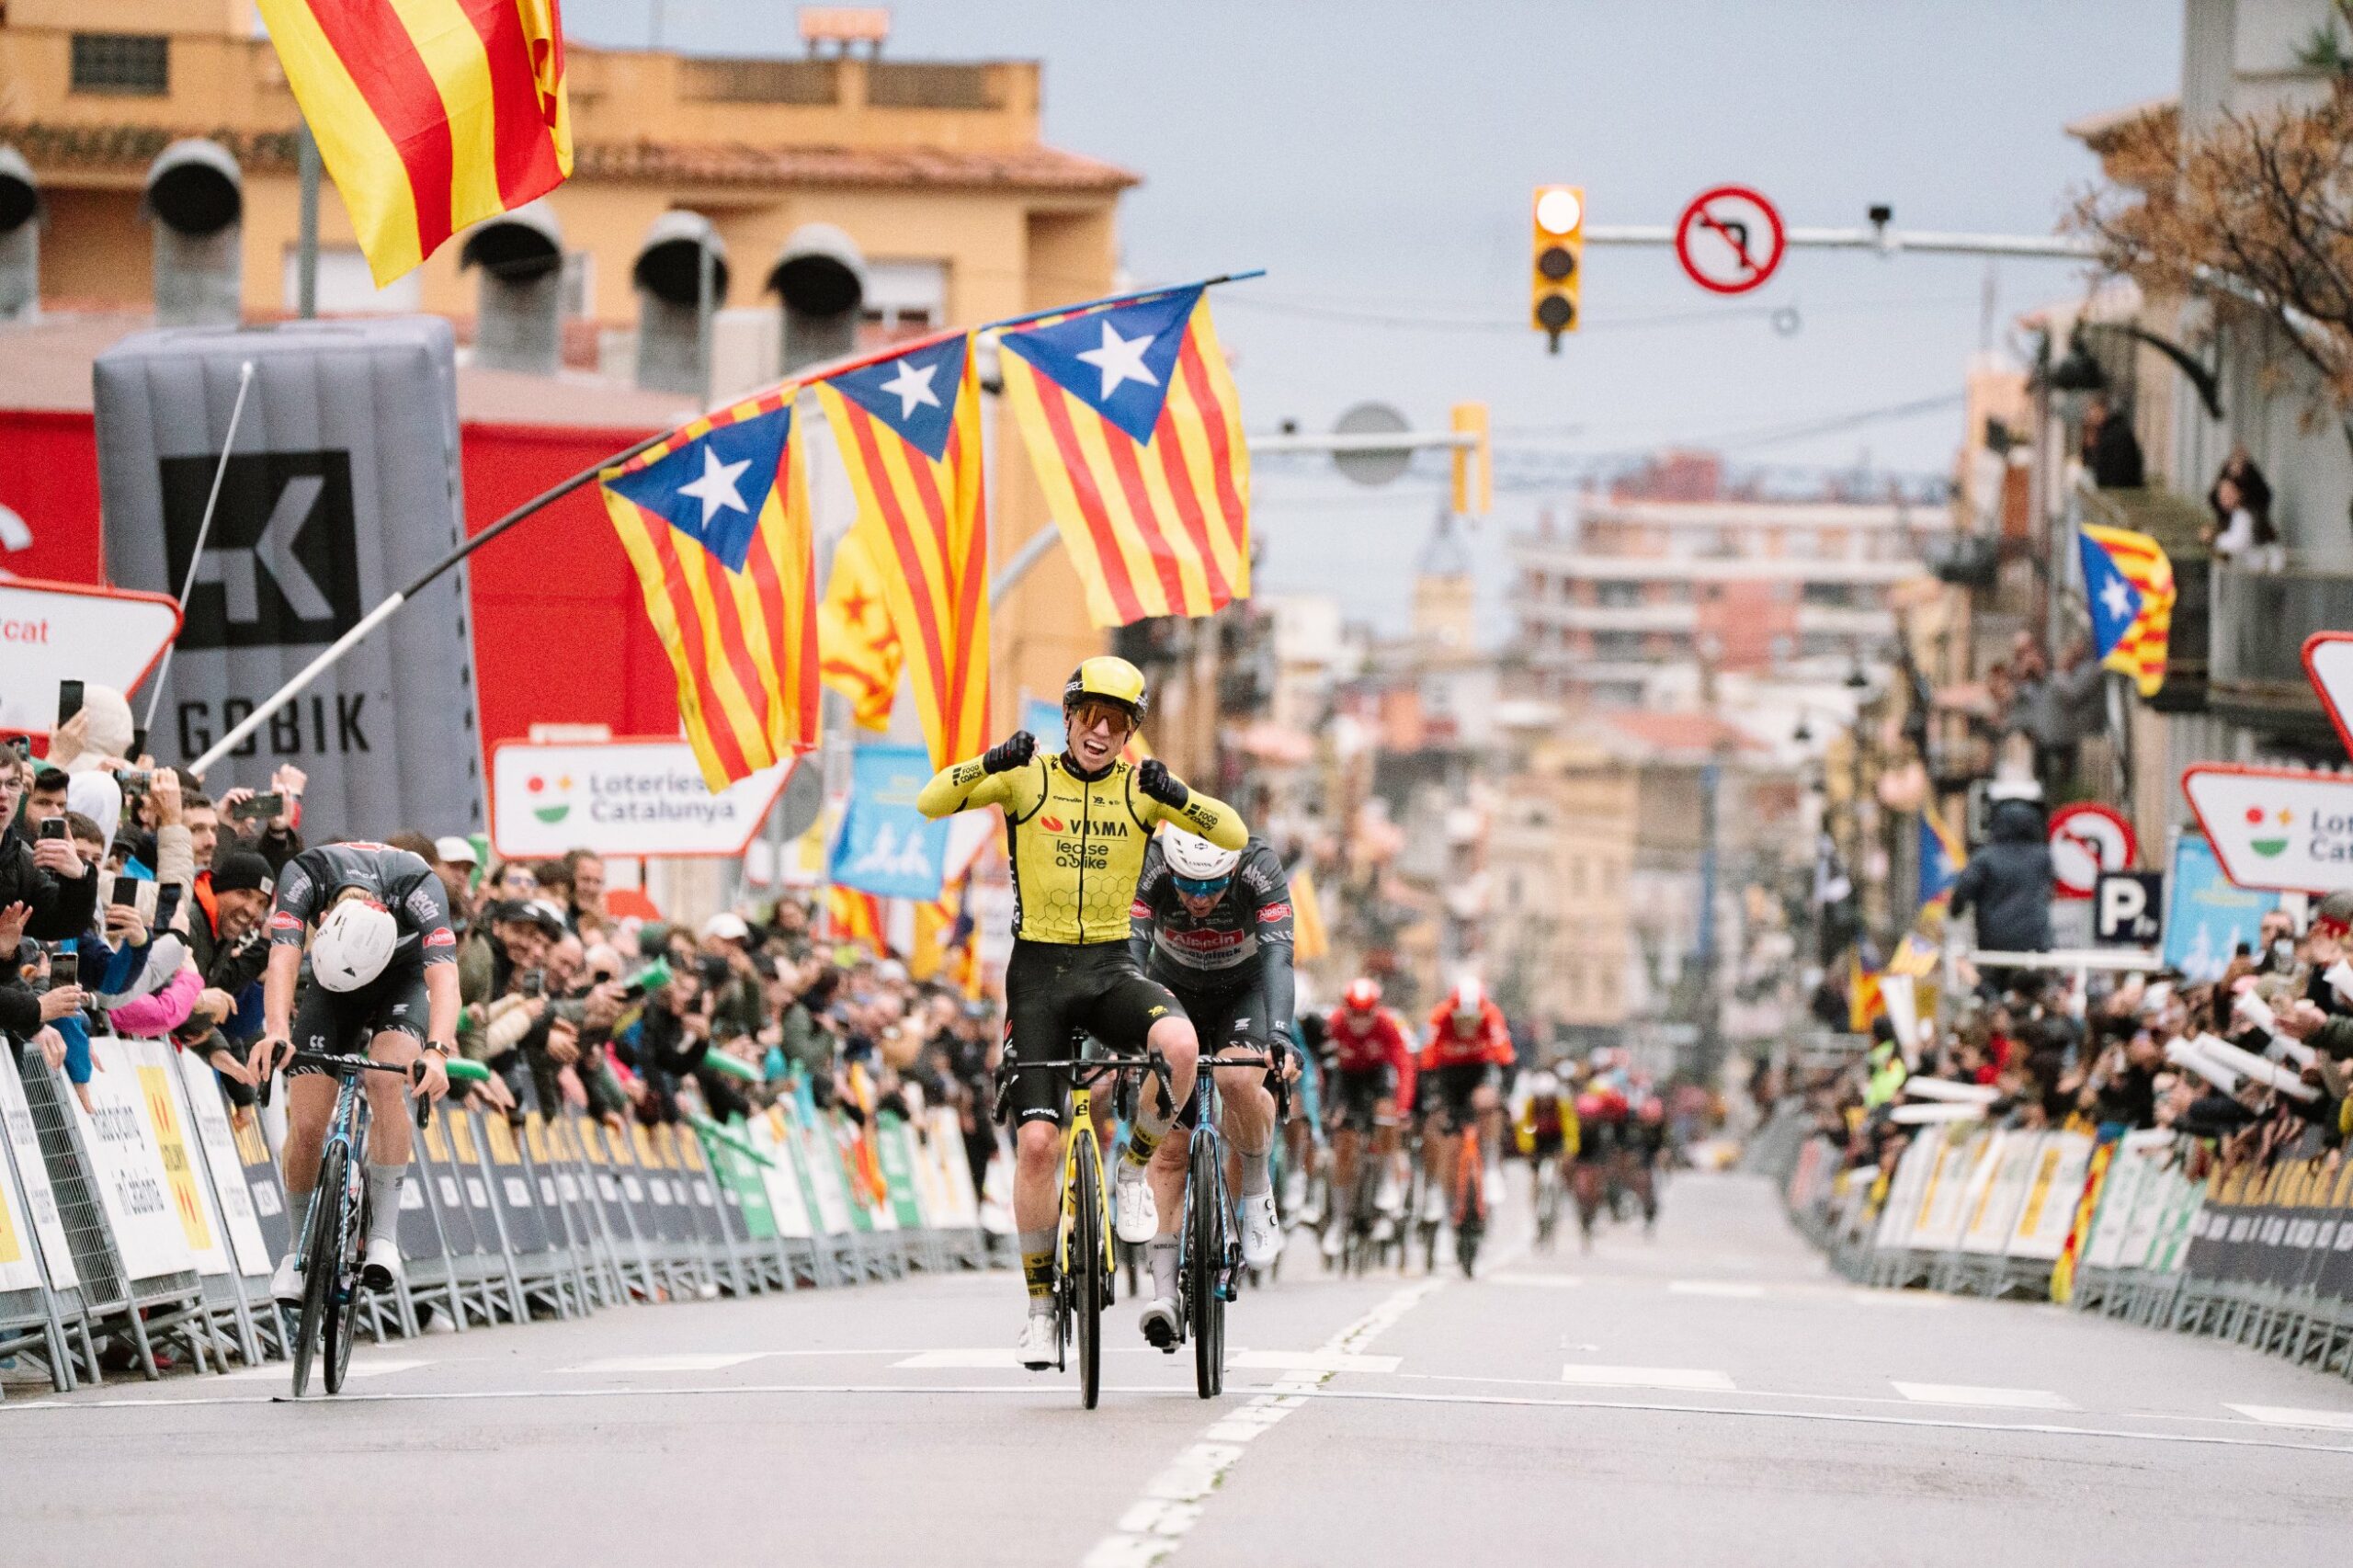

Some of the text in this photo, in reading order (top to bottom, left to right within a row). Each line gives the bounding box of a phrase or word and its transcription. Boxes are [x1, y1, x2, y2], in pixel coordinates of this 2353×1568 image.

[178, 693, 369, 760] GOBIK
[960, 770, 983, 783] COACH
[961, 764, 980, 775] FOOD
[590, 773, 706, 794] Loteries
[590, 799, 735, 823] Catalunya
[1198, 810, 1219, 825] FOOD
[1070, 819, 1128, 837] VISMA
[1056, 839, 1108, 856] lease
[2100, 878, 2147, 936] P
[1173, 932, 1235, 949] Alpecin
